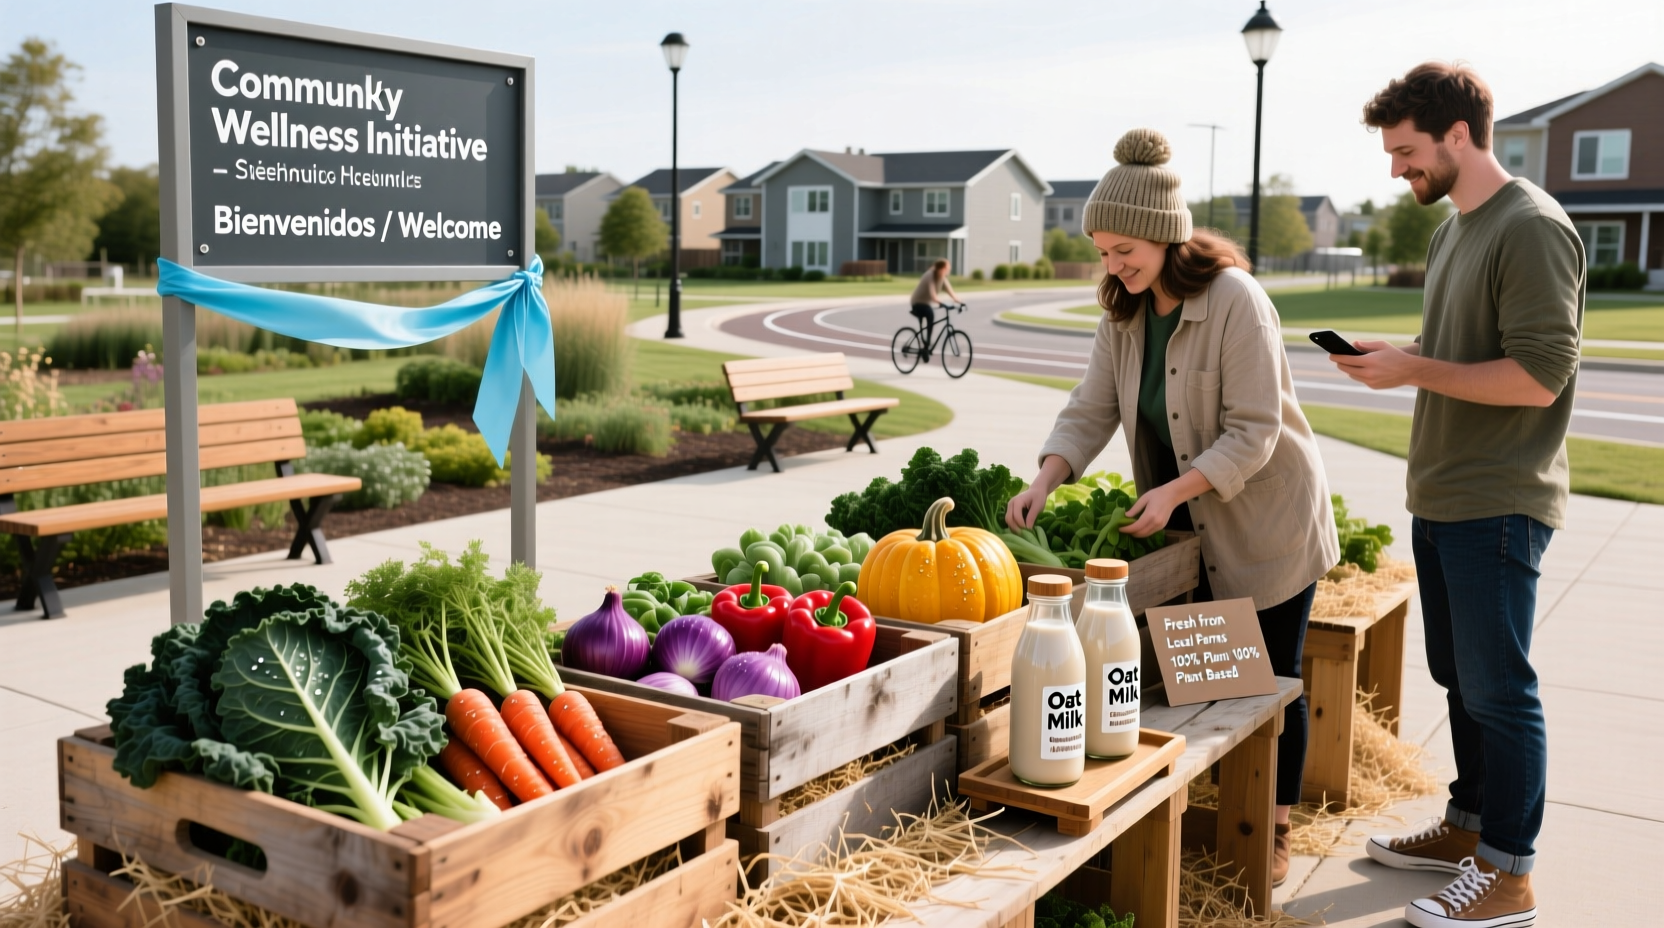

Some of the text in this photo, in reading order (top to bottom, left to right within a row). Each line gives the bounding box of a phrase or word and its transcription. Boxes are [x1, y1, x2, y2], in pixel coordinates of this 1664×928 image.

[211, 107, 488, 161] Wellness Initiative
[214, 205, 502, 243] Bienvenidos / Welcome
[1170, 652, 1201, 668] 100%
[1232, 646, 1260, 661] 100%
[1107, 666, 1138, 685] Oat
[1048, 689, 1082, 710] Oat
[1109, 685, 1139, 705] Milk
[1048, 709, 1083, 730] Milk
